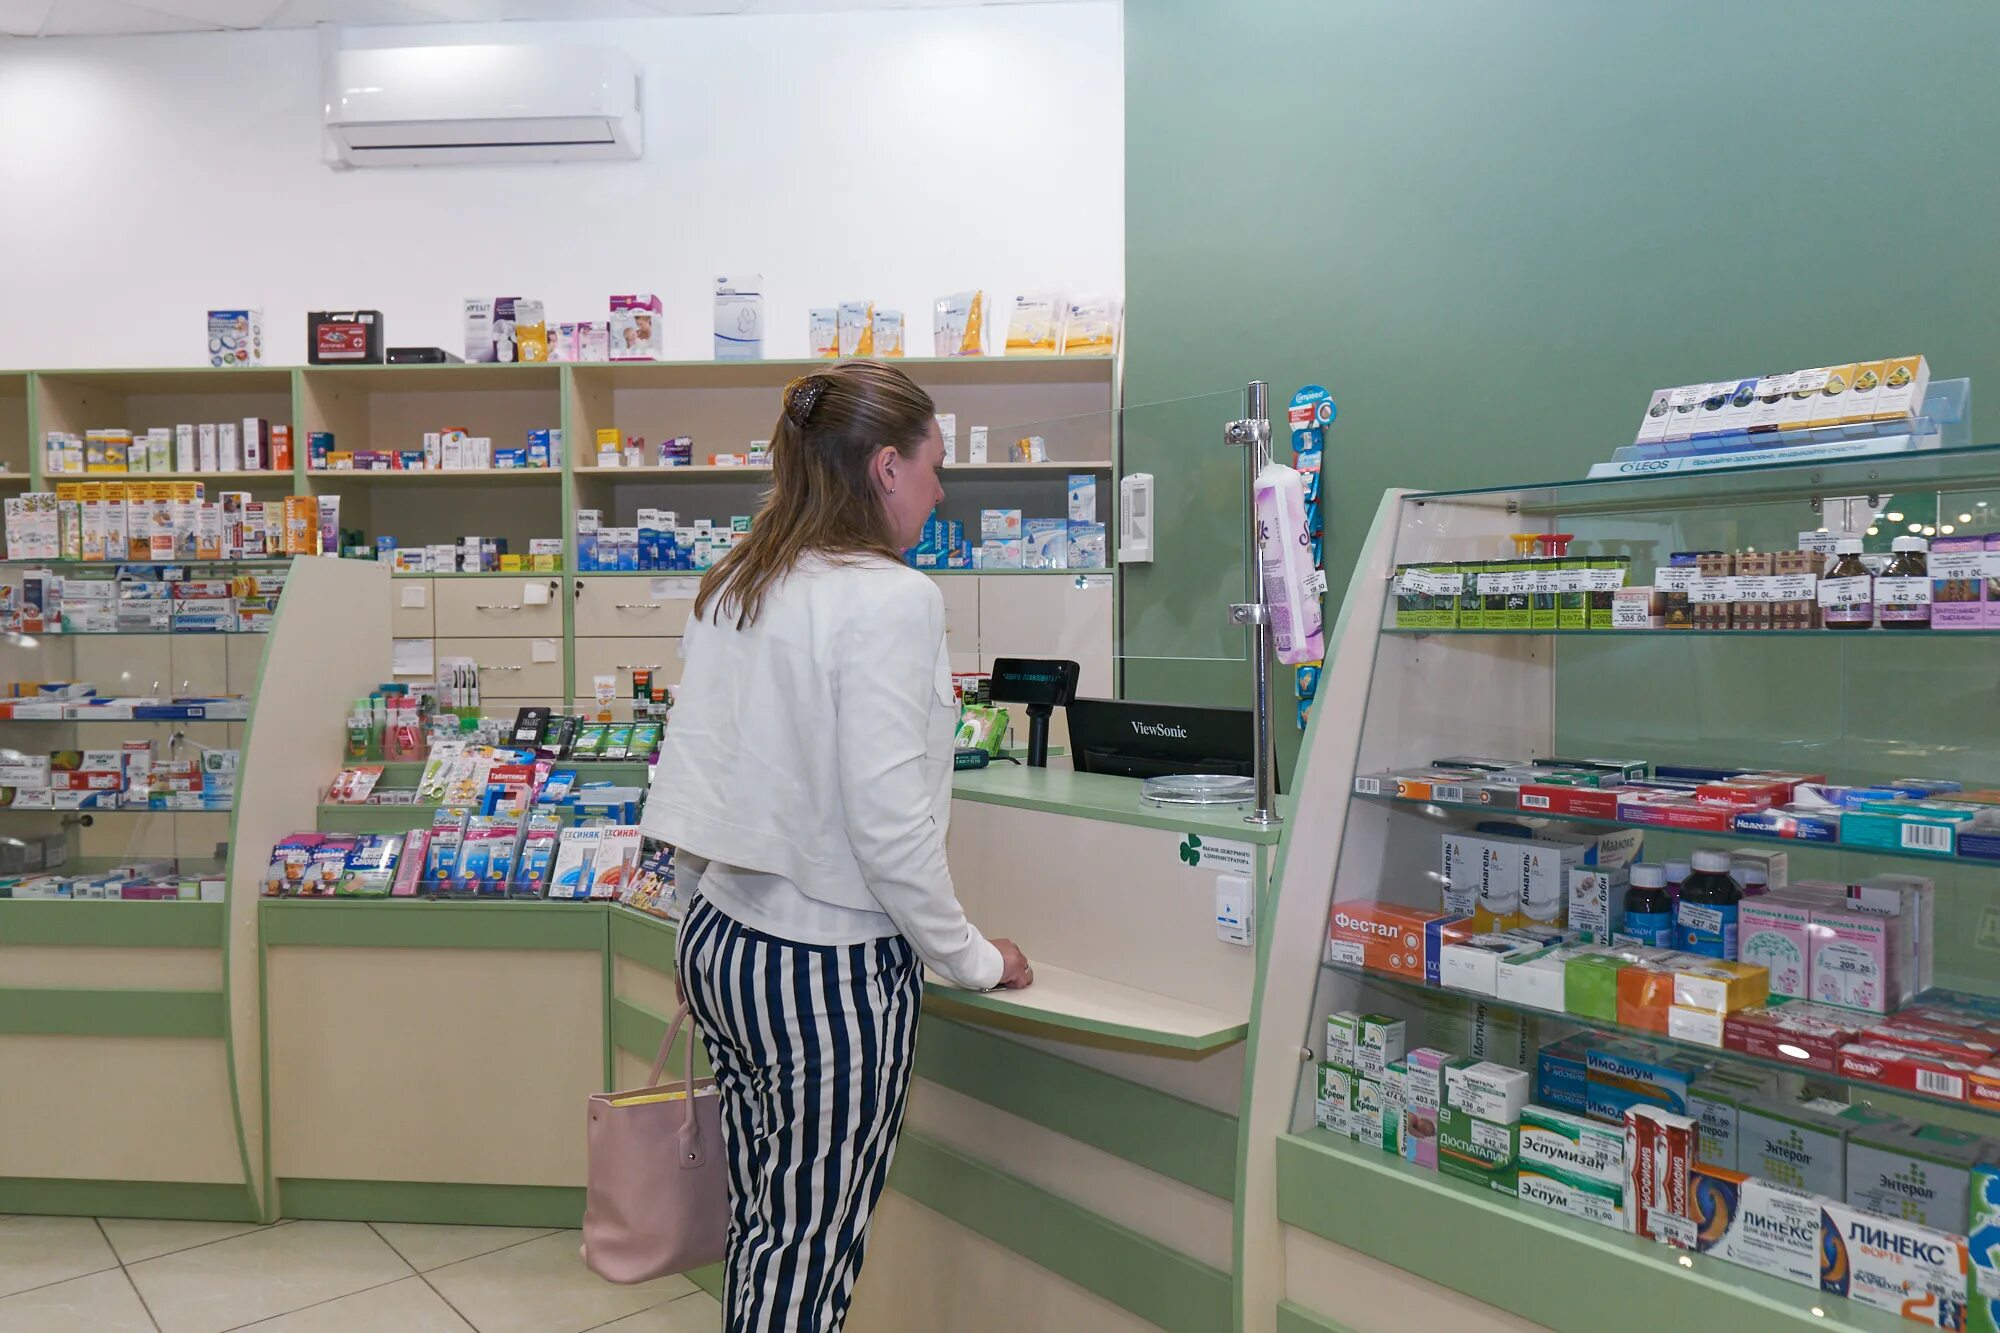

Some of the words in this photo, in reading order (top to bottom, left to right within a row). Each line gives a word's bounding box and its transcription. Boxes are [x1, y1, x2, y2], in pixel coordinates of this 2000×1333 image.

[1131, 720, 1188, 739] ViewSonic
[1737, 819, 1780, 832] Налгези
[1600, 836, 1635, 852] Маалокс
[350, 857, 391, 868] Salonps
[1481, 847, 1490, 900] Алмагель
[1522, 853, 1531, 906] Алмагель
[1691, 919, 1705, 928] 427
[1742, 907, 1782, 919] УКРОПНАЯ
[1783, 913, 1805, 922] ВОДА
[1335, 912, 1399, 939] Фестал
[1813, 918, 1857, 929] УКРОПНАЯ
[1858, 923, 1881, 932] ВОДА
[1426, 960, 1440, 972] 100
[1839, 960, 1855, 969] 205
[1473, 1003, 1487, 1057] Мотилиу
[1362, 1039, 1381, 1051] Креон
[1588, 1054, 1654, 1081] Имодиум
[1842, 1060, 1879, 1076] Rennie
[1323, 1087, 1345, 1101] Креон
[1385, 1090, 1398, 1100] 474
[1415, 1095, 1428, 1104] 403
[1356, 1099, 1379, 1113] Креон
[1587, 1100, 1624, 1121] Имод
[1700, 1124, 1730, 1139] нтерол
[1439, 1133, 1510, 1164] ДЮСПАТАЛИН
[1522, 1136, 1605, 1171] Эспумизан
[1765, 1140, 1811, 1166] Энтерол
[1641, 1148, 1651, 1209] БИФИФОРМ
[1880, 1174, 1934, 1200] Энтерол
[1521, 1183, 1567, 1207] Эспум
[1744, 1211, 1813, 1241] ЛИНЕКС
[1849, 1222, 1944, 1265] ЛИНЕКС
[1860, 1245, 1903, 1264] ФОРТЕ
